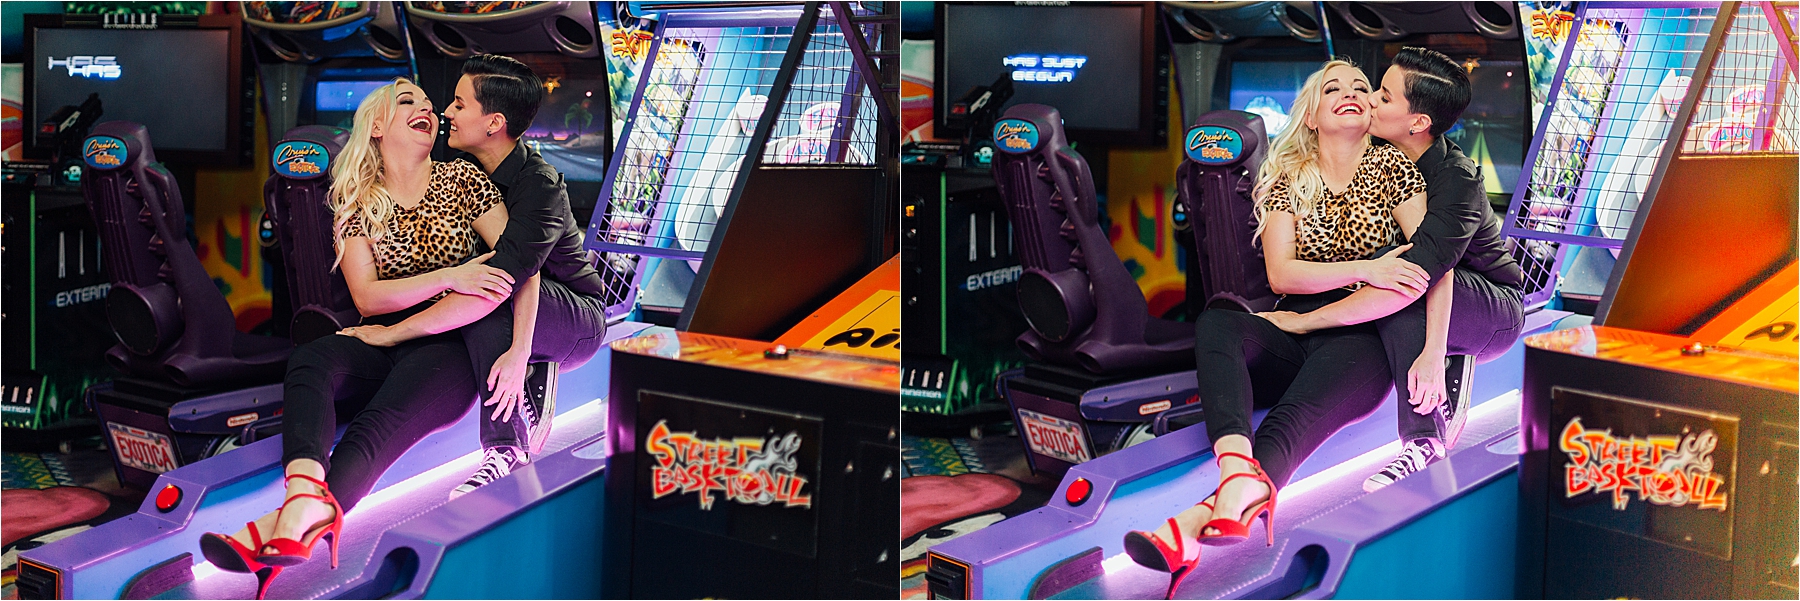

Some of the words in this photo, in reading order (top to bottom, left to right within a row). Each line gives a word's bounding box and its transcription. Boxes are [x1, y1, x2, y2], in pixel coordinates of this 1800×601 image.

[69, 65, 121, 78] HAS
[1003, 57, 1037, 68] HAS
[1042, 57, 1086, 69] JUST
[1012, 70, 1073, 82] BEGUN
[967, 265, 1023, 291] EXTERM
[56, 283, 111, 307] EXTERM
[116, 435, 176, 470] EXOTICA
[647, 420, 765, 469] STREET
[1027, 423, 1087, 459] EXOTICA
[1560, 416, 1682, 466] STREET
